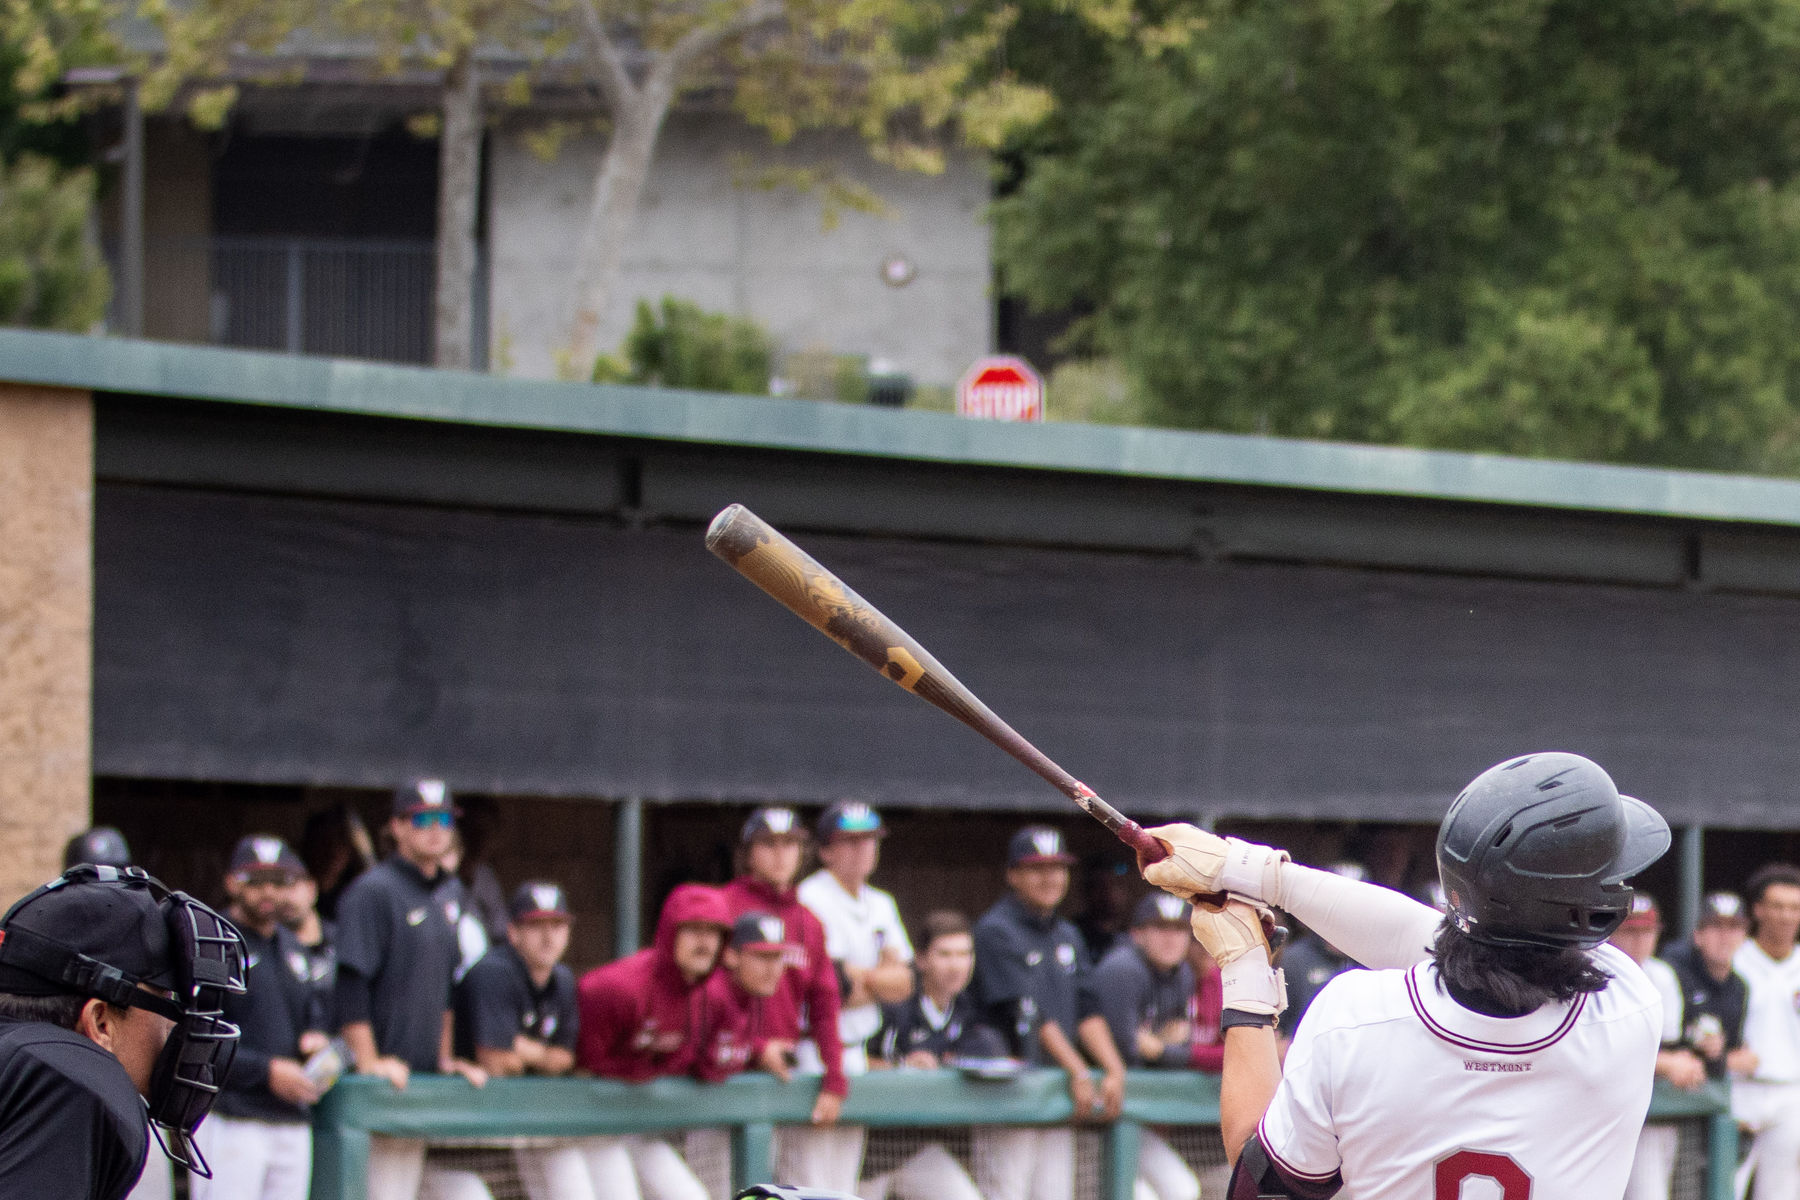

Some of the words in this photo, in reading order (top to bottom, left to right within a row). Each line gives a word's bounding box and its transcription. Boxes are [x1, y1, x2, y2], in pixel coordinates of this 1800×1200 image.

[253, 838, 281, 863] W
[1034, 831, 1059, 855] W
[532, 886, 559, 910] W
[1711, 893, 1739, 917] W
[1463, 1061, 1532, 1073] WESTMONT
